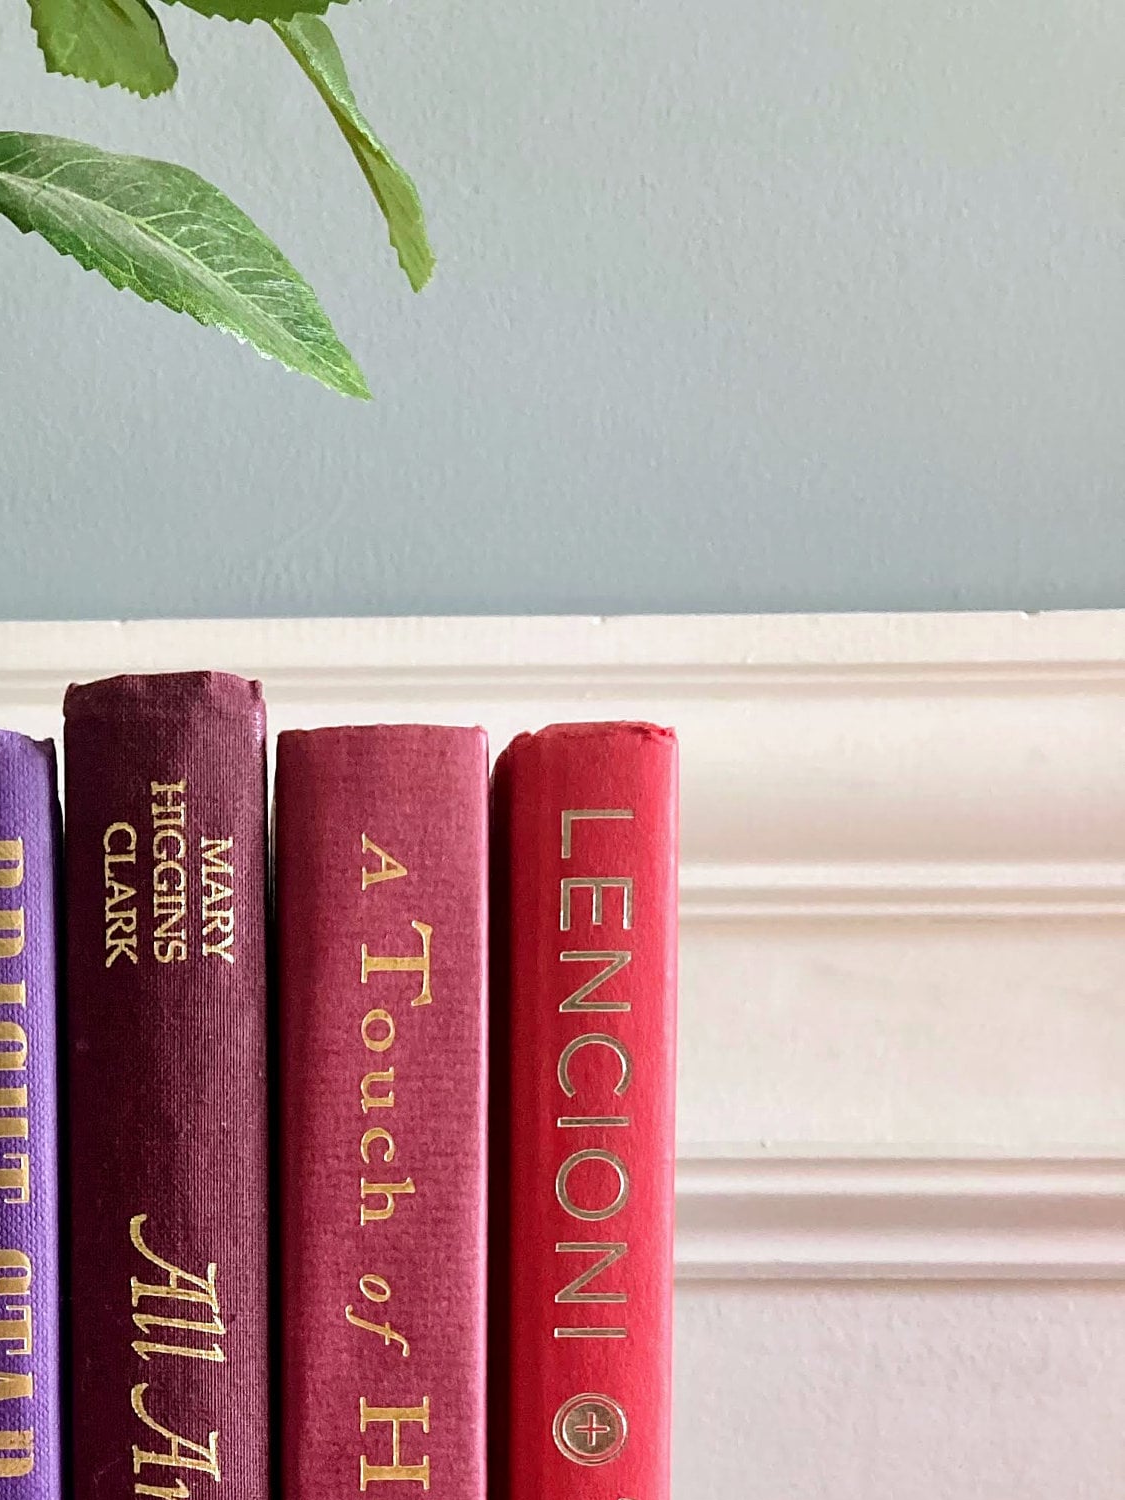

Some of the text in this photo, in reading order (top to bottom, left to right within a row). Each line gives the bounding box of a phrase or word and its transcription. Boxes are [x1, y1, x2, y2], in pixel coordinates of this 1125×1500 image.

[102, 821, 138, 968] CLARK
[150, 779, 187, 964] HIGGINS
[200, 836, 235, 965] MARY
[360, 833, 408, 891] A
[359, 920, 433, 1226] Touch
[553, 808, 635, 1338] LENCIONI
[130, 1213, 226, 1362] All
[345, 1273, 410, 1357] of
